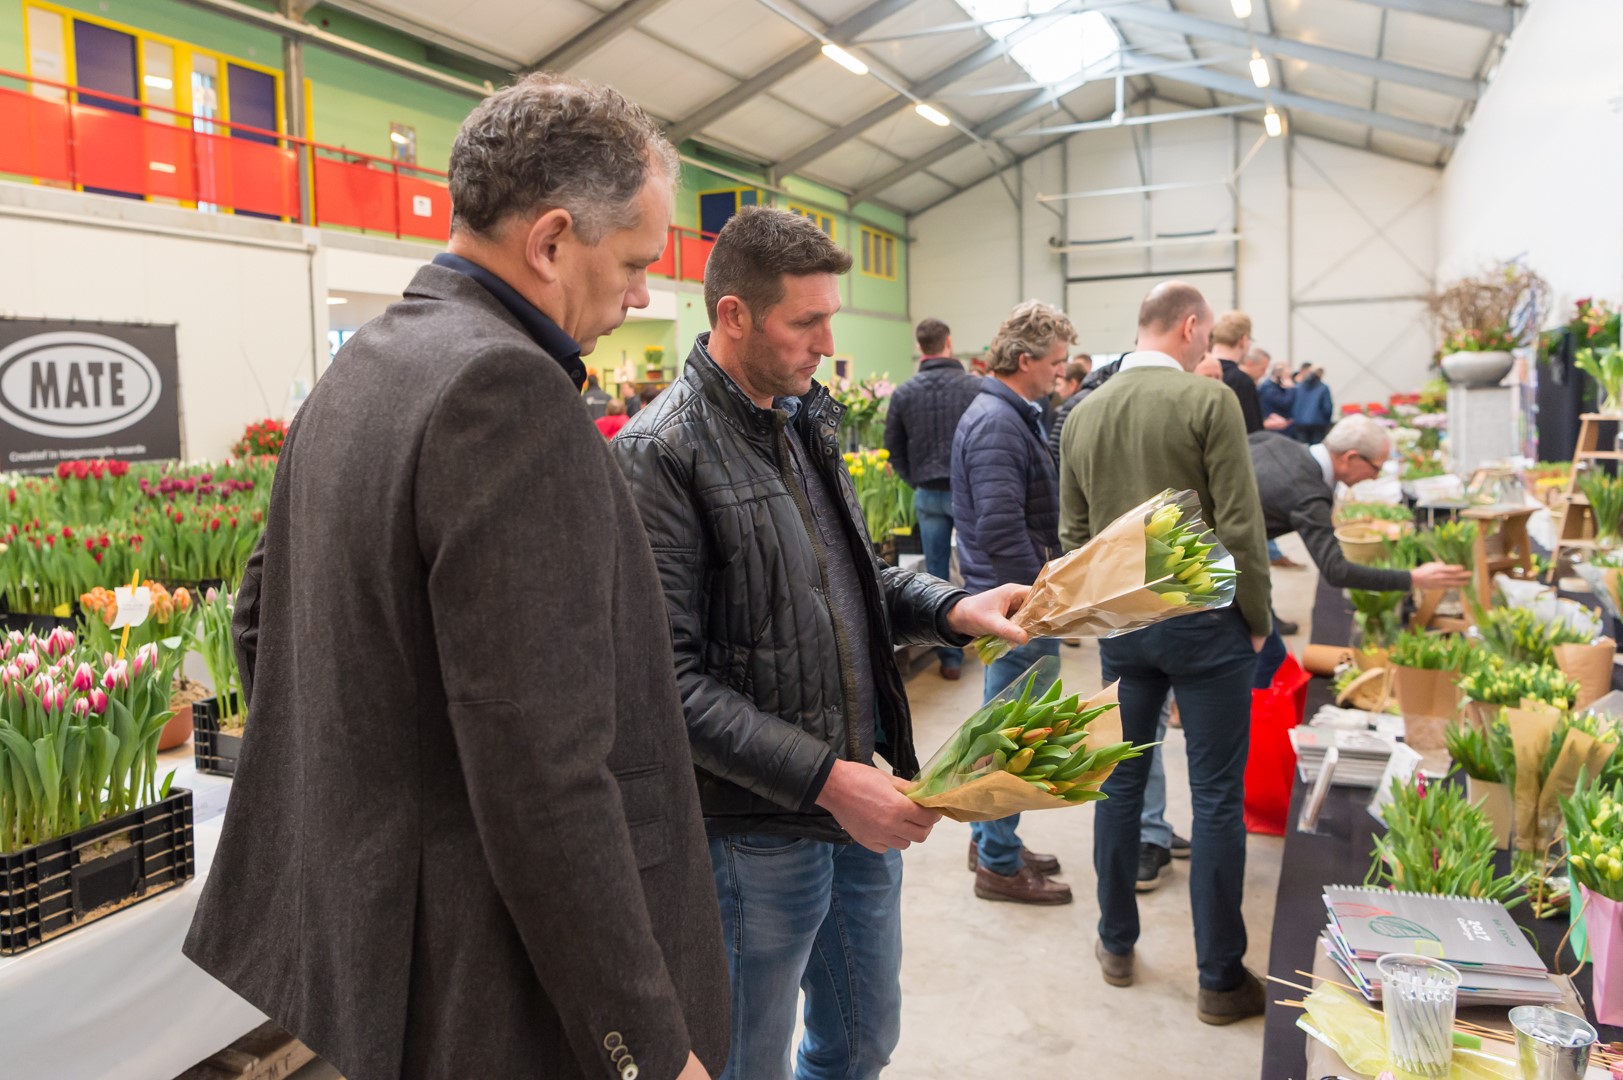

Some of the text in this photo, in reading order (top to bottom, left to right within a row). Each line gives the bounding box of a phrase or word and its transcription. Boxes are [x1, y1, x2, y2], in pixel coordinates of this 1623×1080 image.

[30, 361, 126, 408] MATE
[9, 450, 48, 463] Creatief
[49, 450, 58, 460] in
[1467, 919, 1491, 941] 2017
